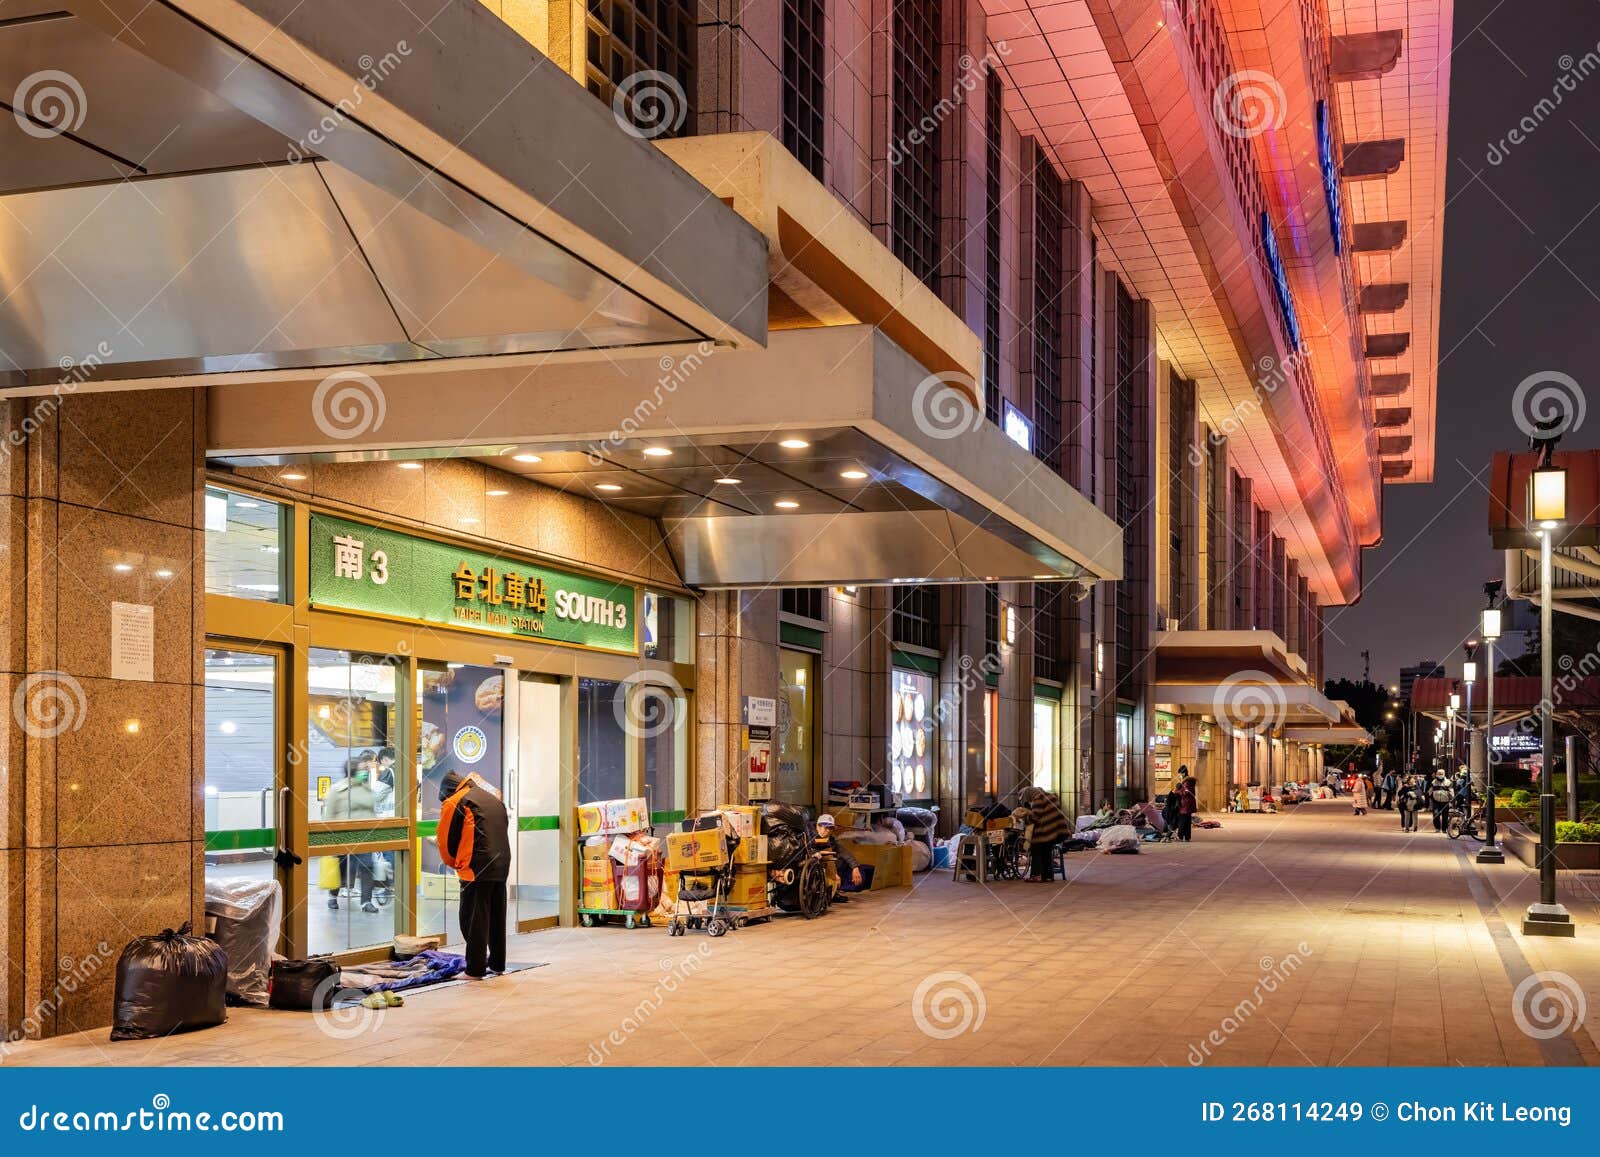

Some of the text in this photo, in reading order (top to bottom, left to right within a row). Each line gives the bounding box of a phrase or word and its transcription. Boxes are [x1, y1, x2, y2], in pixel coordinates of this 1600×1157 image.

[333, 534, 390, 585] 南 3
[452, 561, 548, 613] 台北車站
[555, 589, 627, 629] SOUTH 3
[454, 606, 545, 634] TAIPEI MAIN STATION
